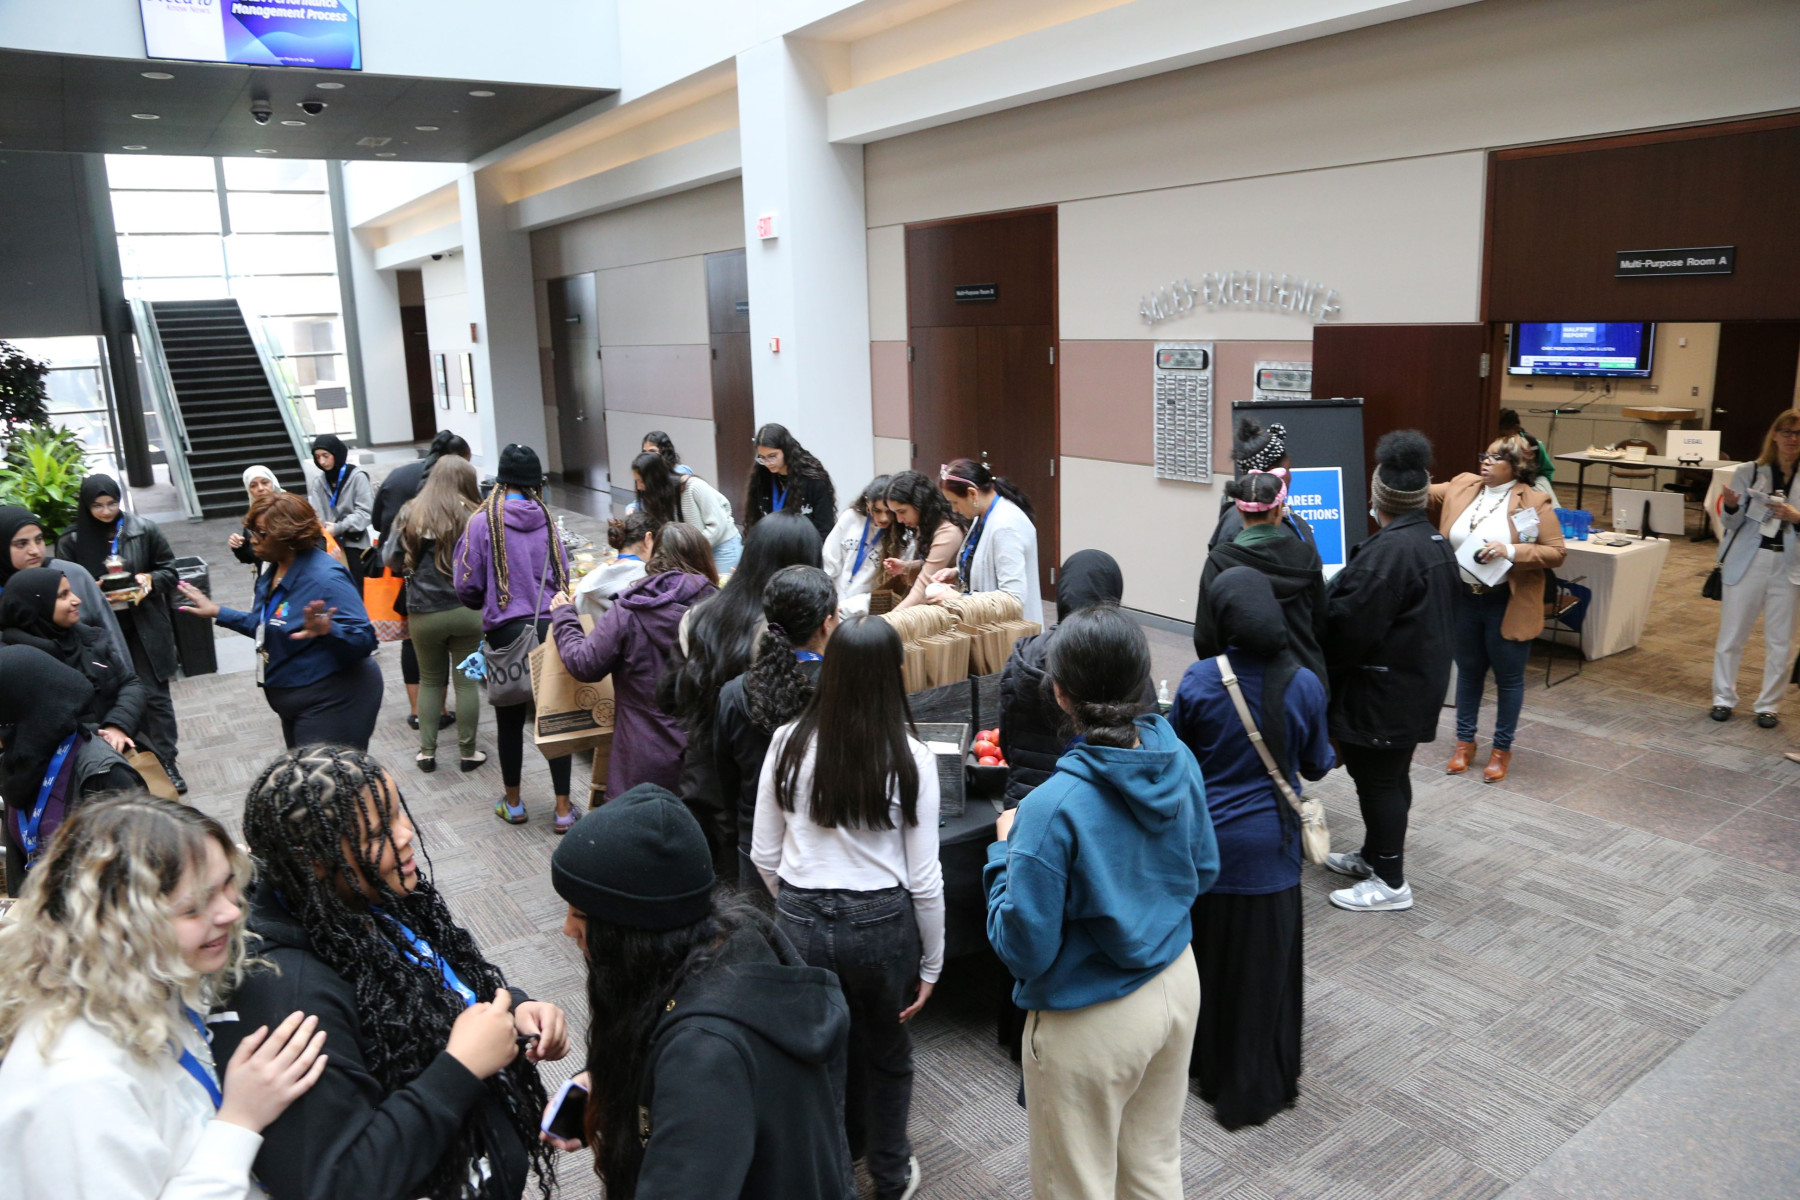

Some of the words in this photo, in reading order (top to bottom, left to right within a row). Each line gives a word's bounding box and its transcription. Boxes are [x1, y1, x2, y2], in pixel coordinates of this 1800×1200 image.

[270, 0, 338, 8] ormance
[232, 2, 305, 19] Management
[306, 8, 347, 22] Process
[1620, 259, 1684, 268] Multi-Purpose
[1686, 257, 1715, 266] Room
[1718, 256, 1727, 265] A
[1140, 277, 1194, 325] SALES
[1203, 270, 1338, 323] EXCELLENCE
[1294, 508, 1339, 520] ECTIONS
